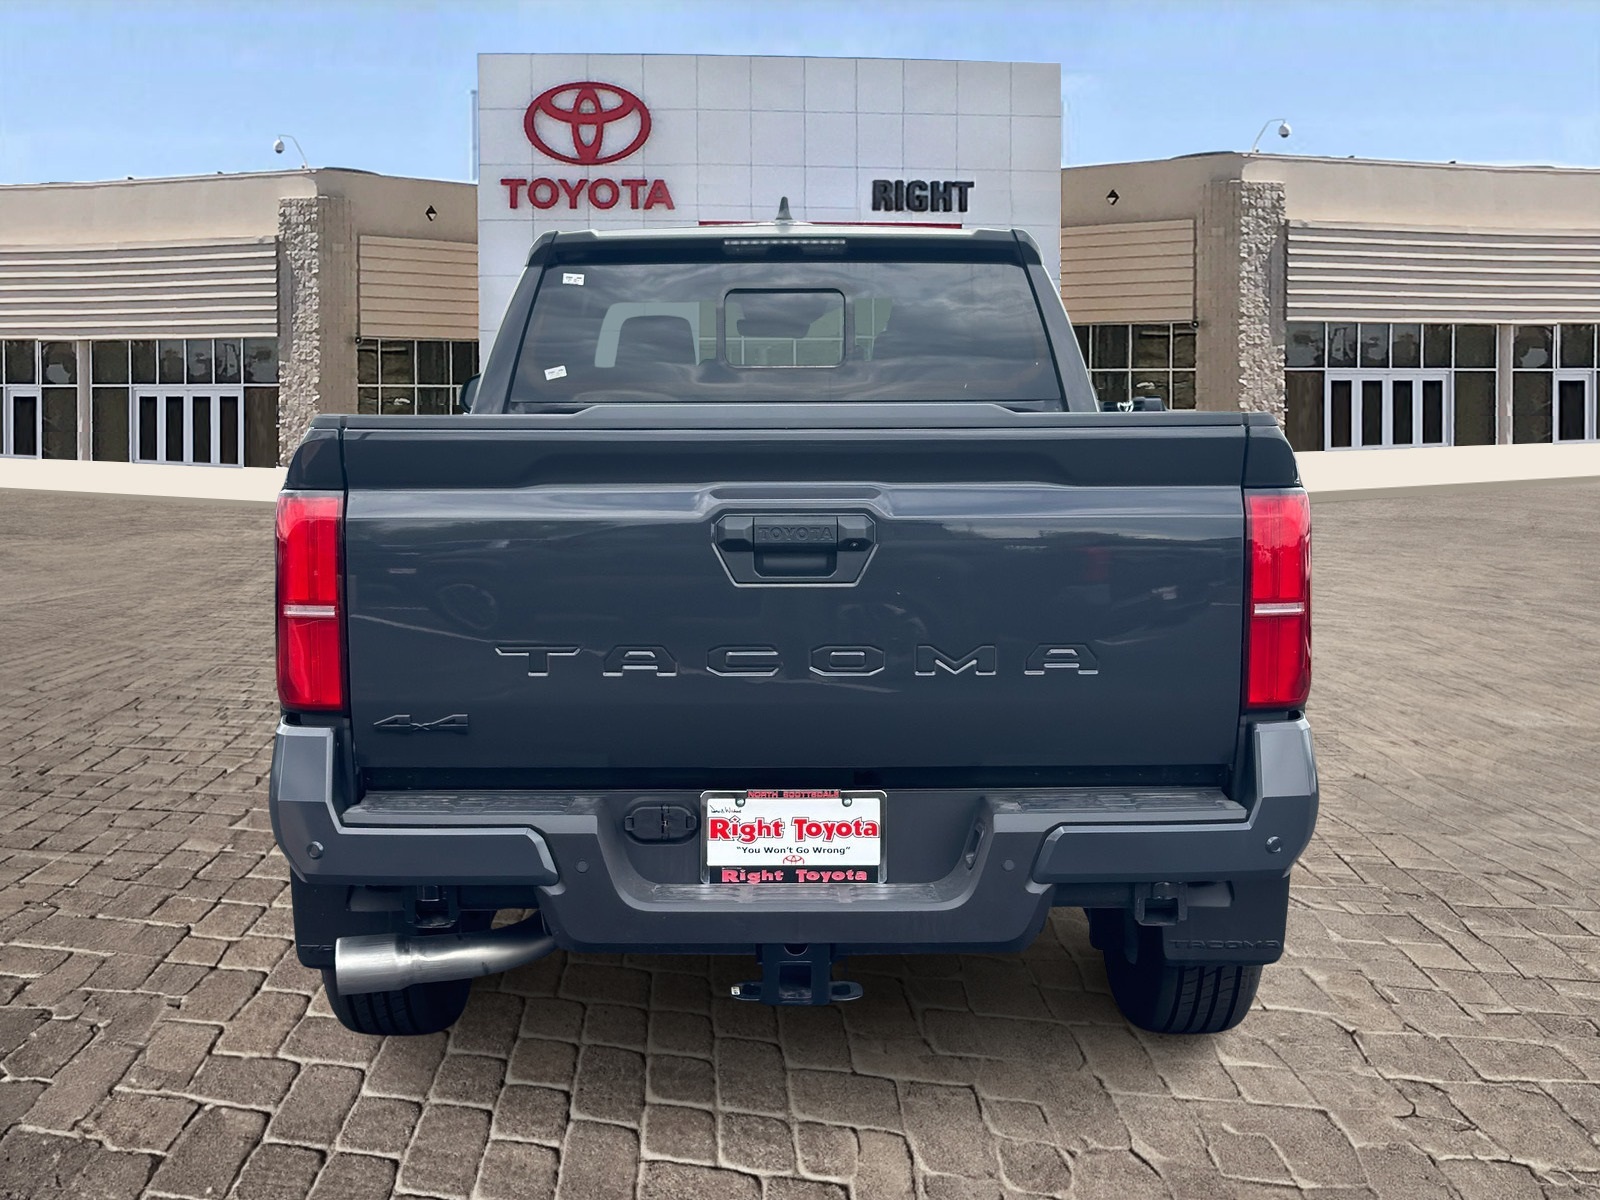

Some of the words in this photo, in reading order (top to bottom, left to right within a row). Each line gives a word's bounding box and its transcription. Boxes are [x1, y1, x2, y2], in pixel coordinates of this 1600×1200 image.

[500, 178, 675, 210] TOYOTA
[871, 179, 975, 213] RIGHT
[758, 527, 834, 541] TOYOTA
[495, 643, 1099, 678] TACOMA
[748, 790, 778, 798] NORTH
[708, 815, 786, 843] Right
[791, 816, 880, 842] Toyota
[764, 846, 792, 854] Won't
[796, 846, 810, 854] Go
[721, 868, 784, 884] Right
[796, 868, 868, 882] Toyota
